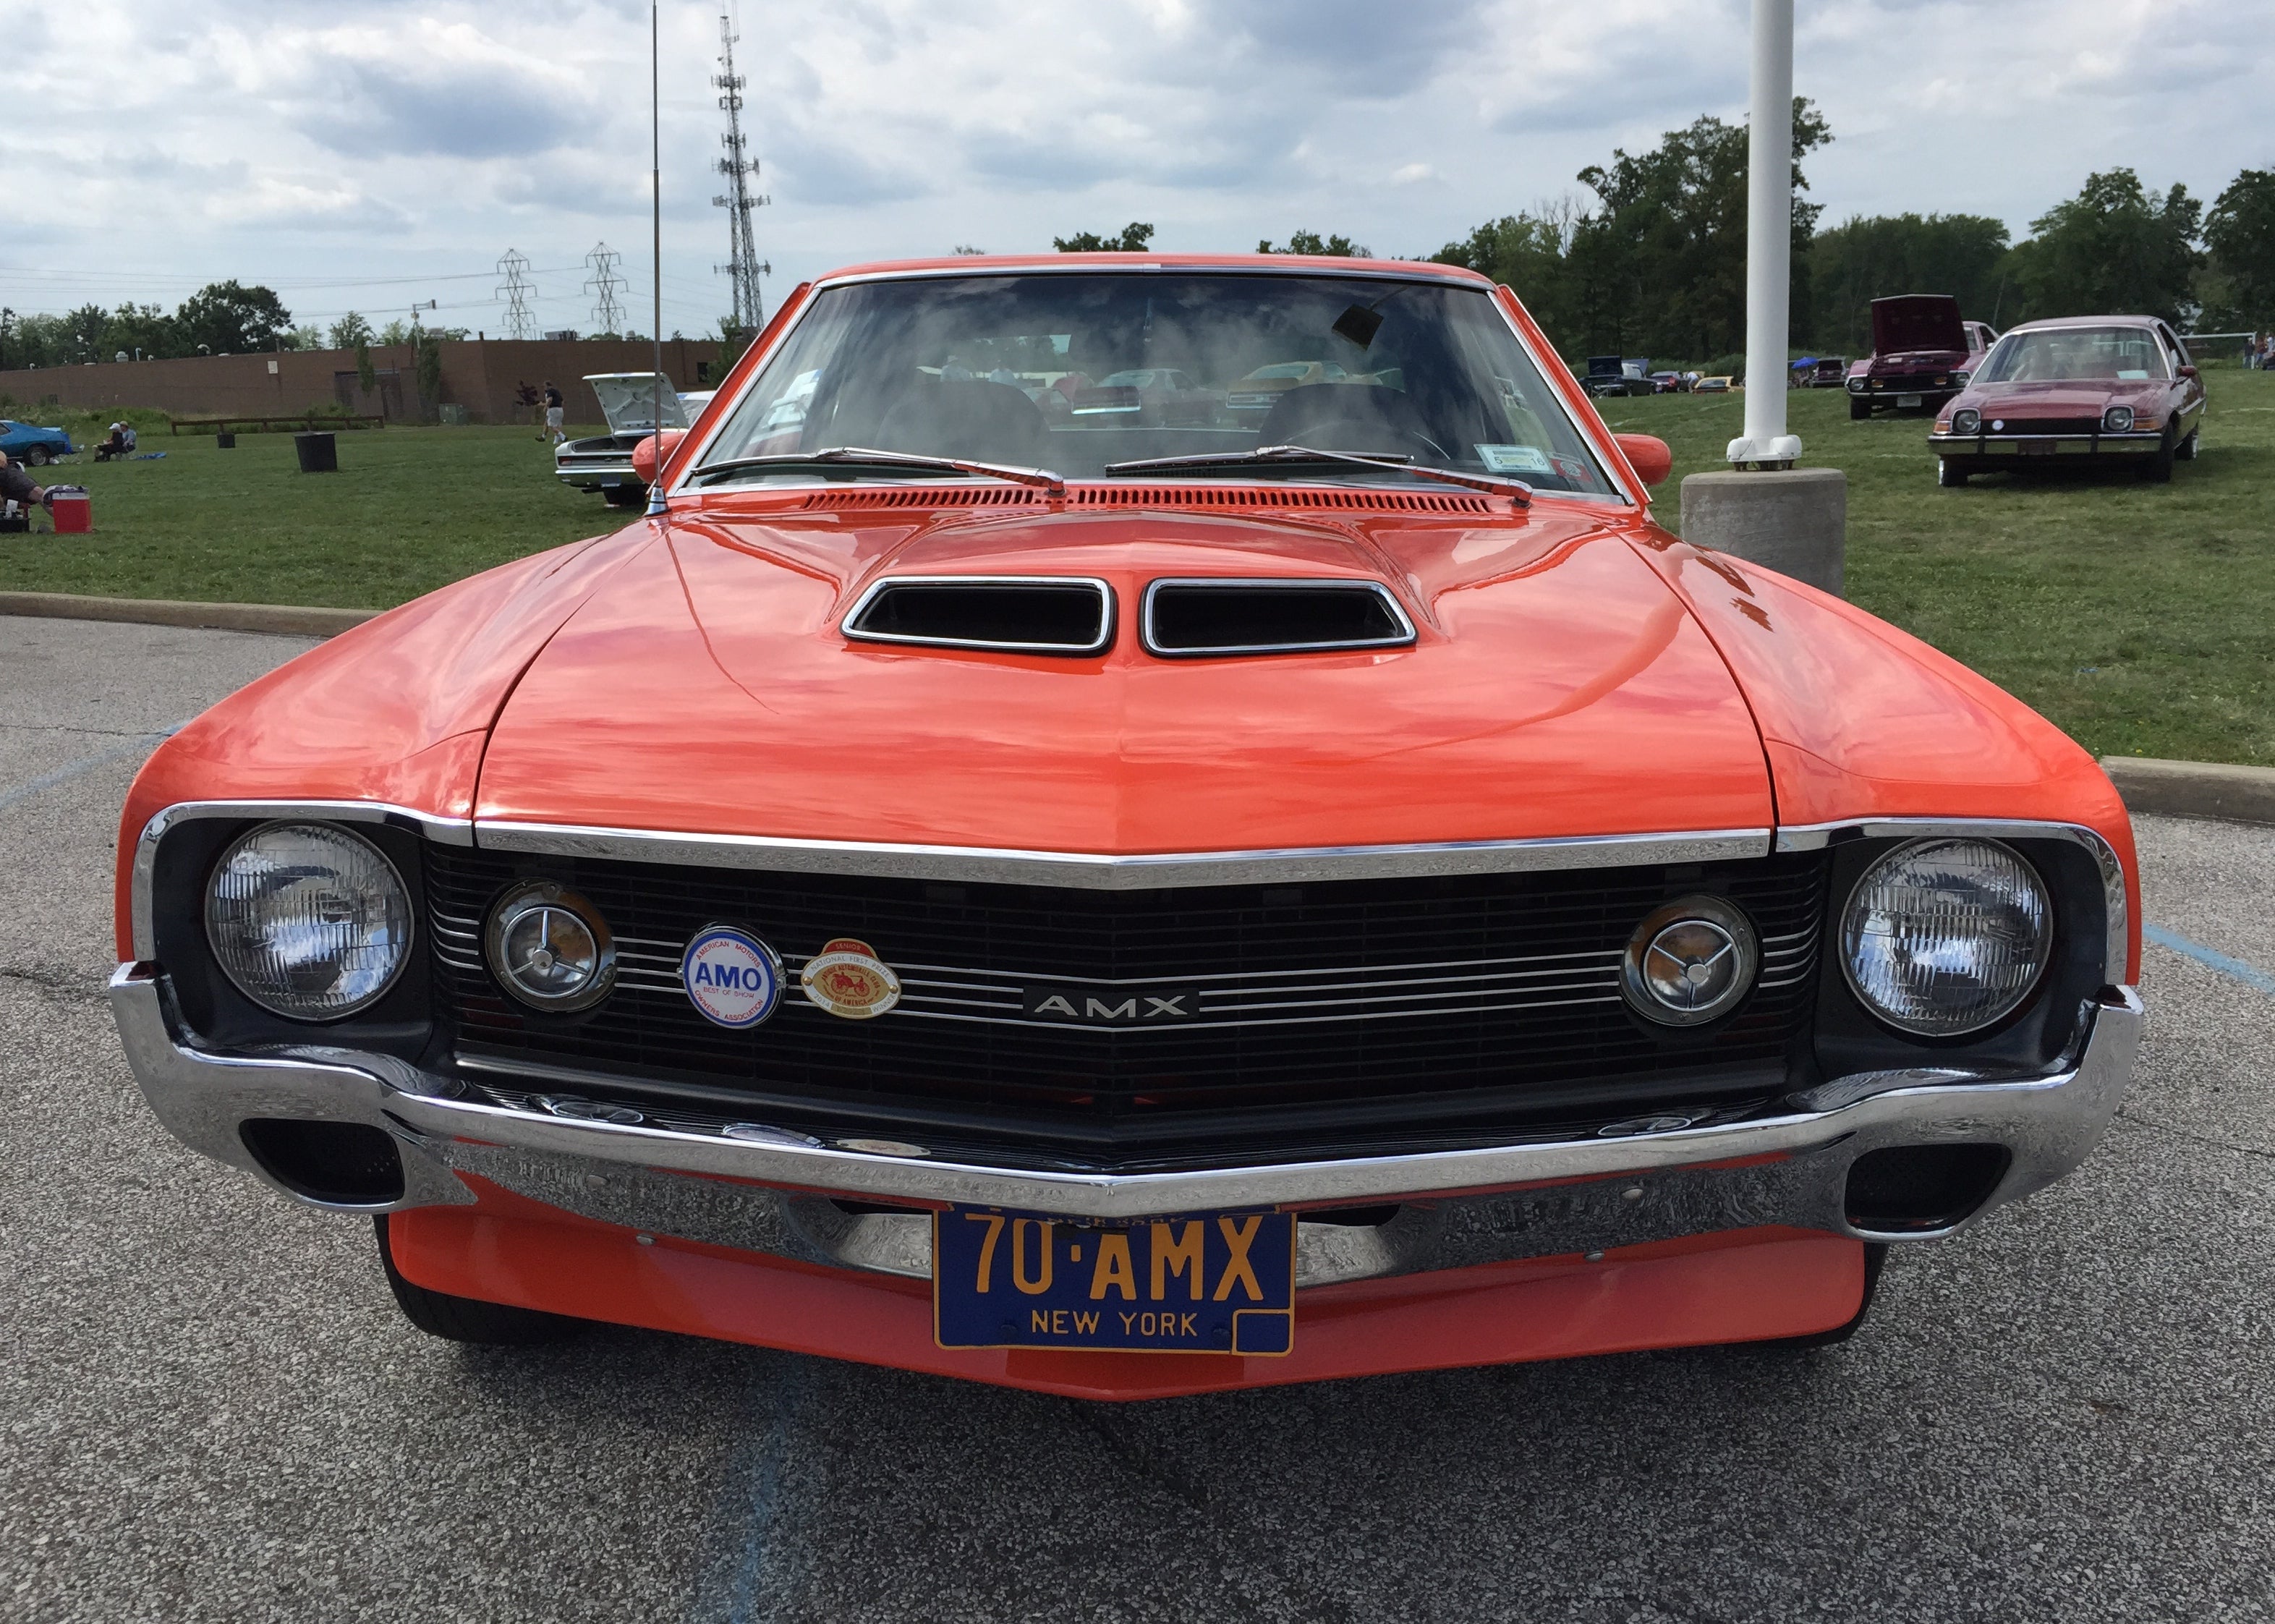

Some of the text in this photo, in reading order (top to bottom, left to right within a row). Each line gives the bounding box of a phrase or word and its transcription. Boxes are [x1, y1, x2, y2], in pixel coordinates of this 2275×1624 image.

[1494, 456, 1503, 464] 5
[1531, 457, 1545, 467] 16
[696, 941, 762, 968] AMERICAN MOTORS
[811, 956, 890, 978] NATIONAL FIRST PRIZE
[695, 961, 762, 991] AMO
[695, 990, 763, 1021] OWNERS ASSOCIATION
[873, 995, 896, 1012] WINNER
[1034, 995, 1188, 1019] AMX
[1031, 1309, 1197, 1337] NEW YORK
